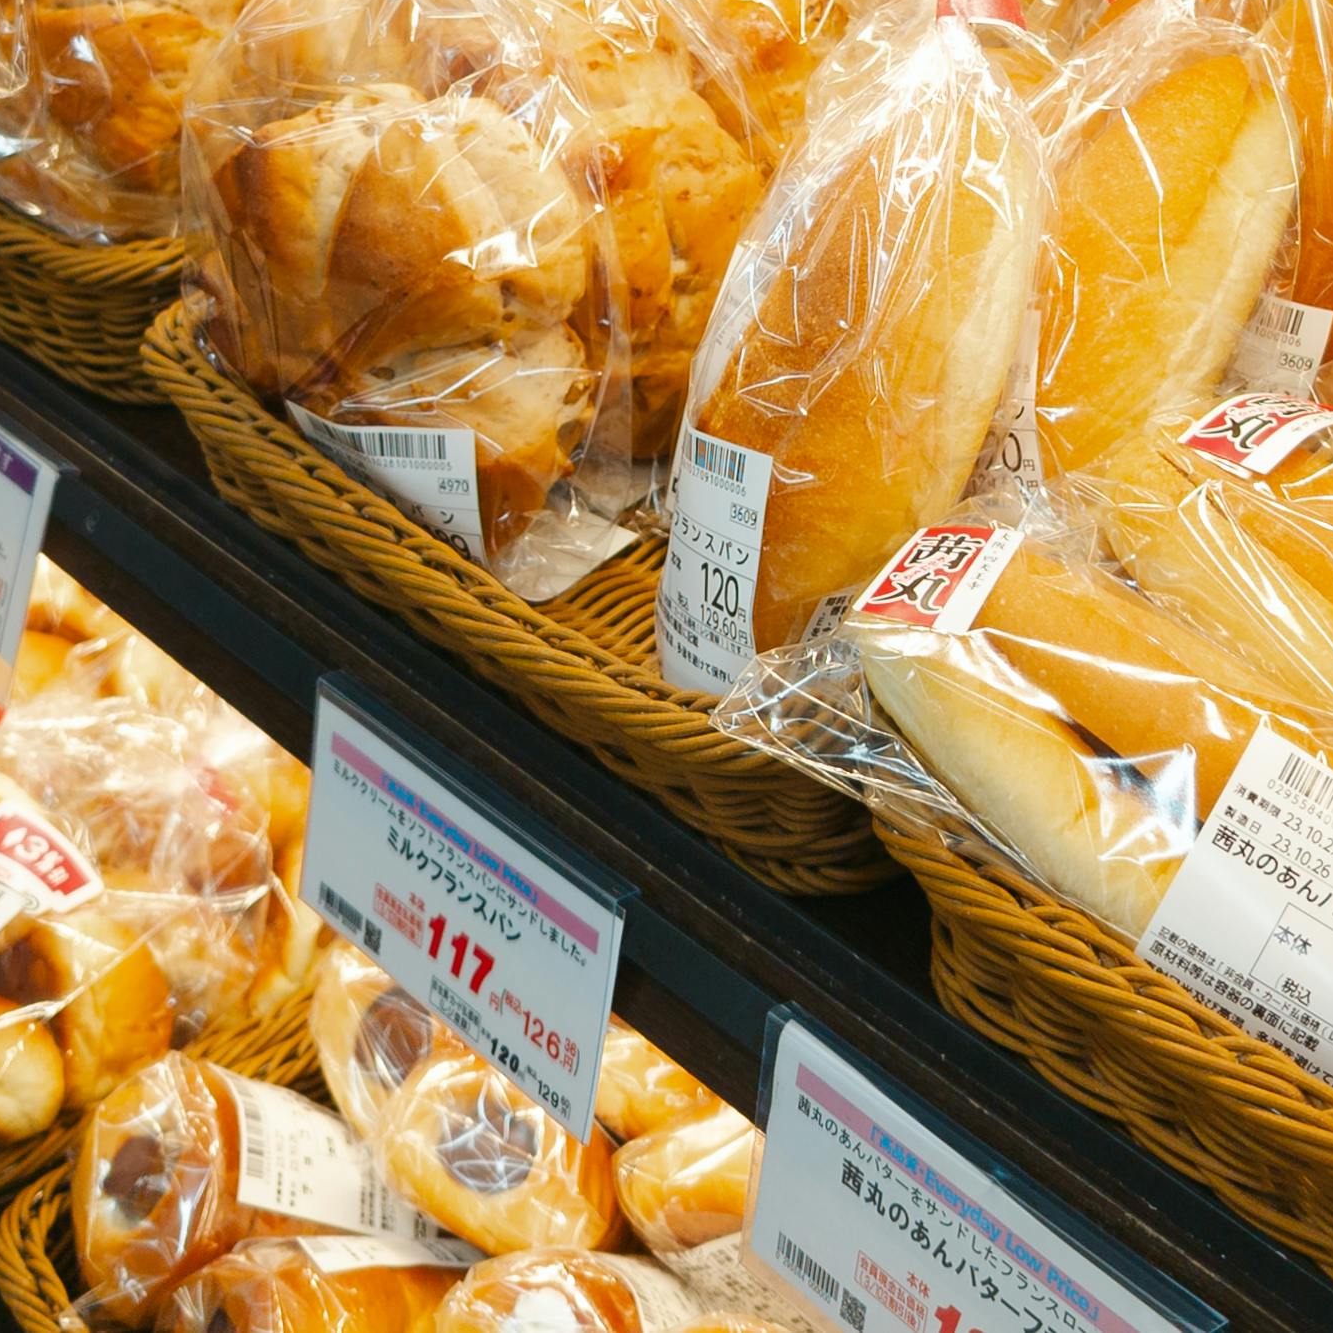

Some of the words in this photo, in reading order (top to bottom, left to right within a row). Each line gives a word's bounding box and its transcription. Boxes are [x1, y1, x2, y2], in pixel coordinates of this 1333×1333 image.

[1279, 353, 1314, 372] 3609
[439, 479, 469, 493] 4970
[731, 504, 758, 525] 3609
[870, 535, 985, 613] 茜丸
[1233, 783, 1281, 819] 消費期限
[1225, 804, 1263, 835] 製造日
[1271, 833, 1331, 879] 23.10.26
[387, 825, 522, 942] ミルクフランスパン
[1273, 924, 1312, 956] 本体
[1149, 940, 1319, 1053] 原材料等は容器の裏面に記載
[1004, 1231, 1042, 1277] Low
[907, 1270, 930, 1300] 本体
